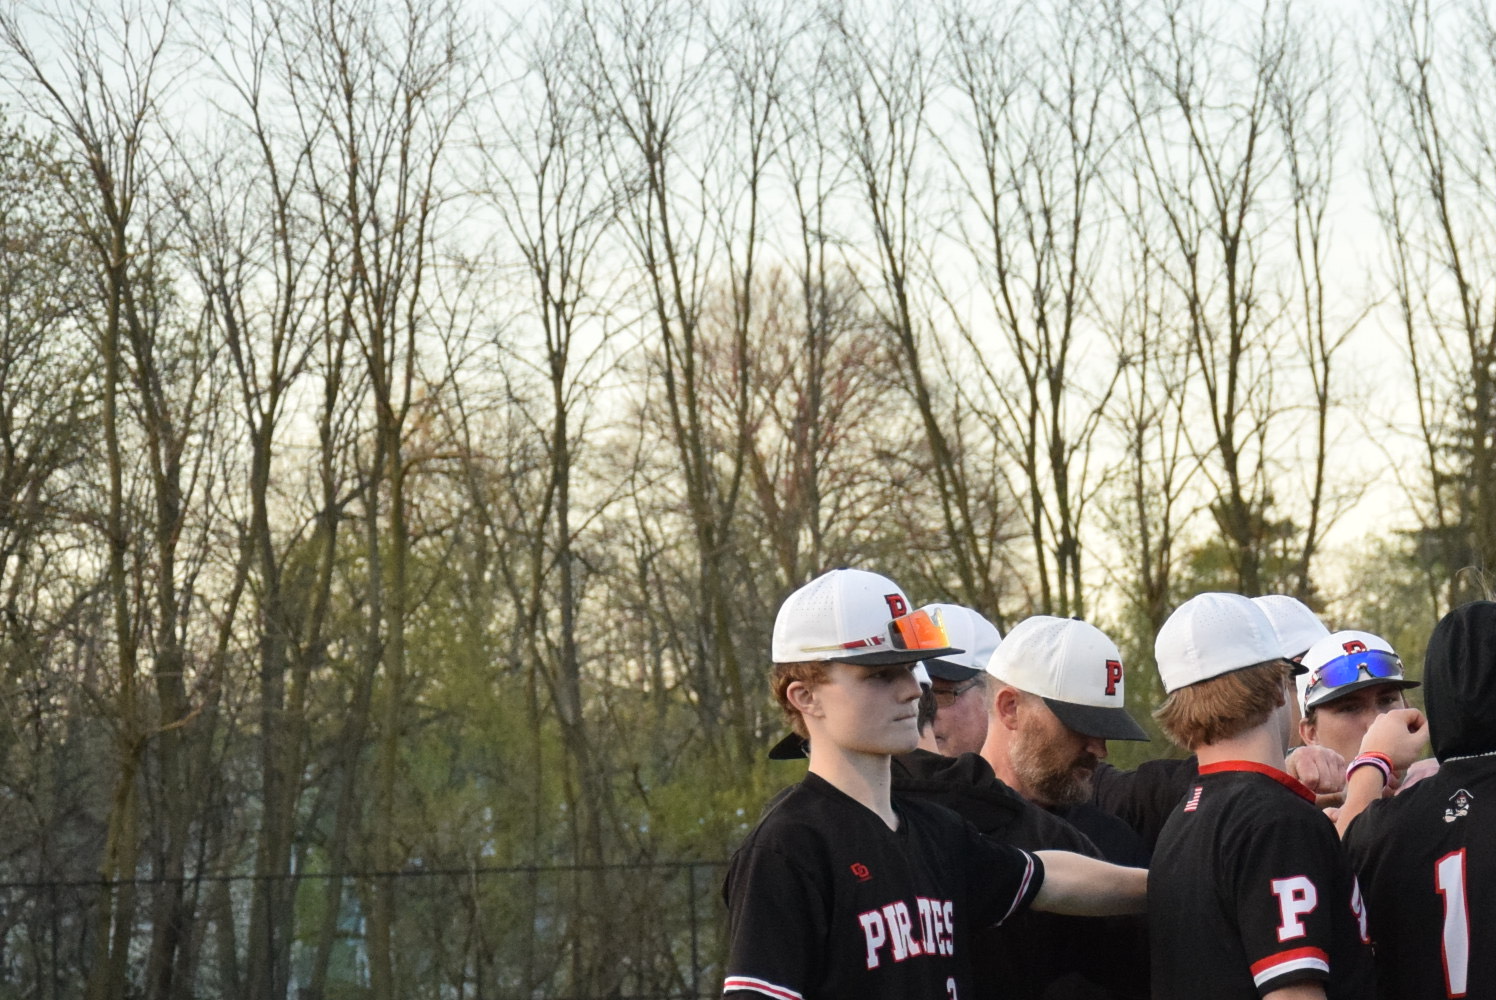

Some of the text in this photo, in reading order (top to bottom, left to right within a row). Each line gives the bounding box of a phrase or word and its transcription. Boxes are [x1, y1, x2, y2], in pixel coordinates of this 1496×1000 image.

[1105, 659, 1122, 696] P
[858, 896, 954, 970] PIRTES
[1270, 875, 1318, 943] P
[1434, 847, 1470, 999] 1
